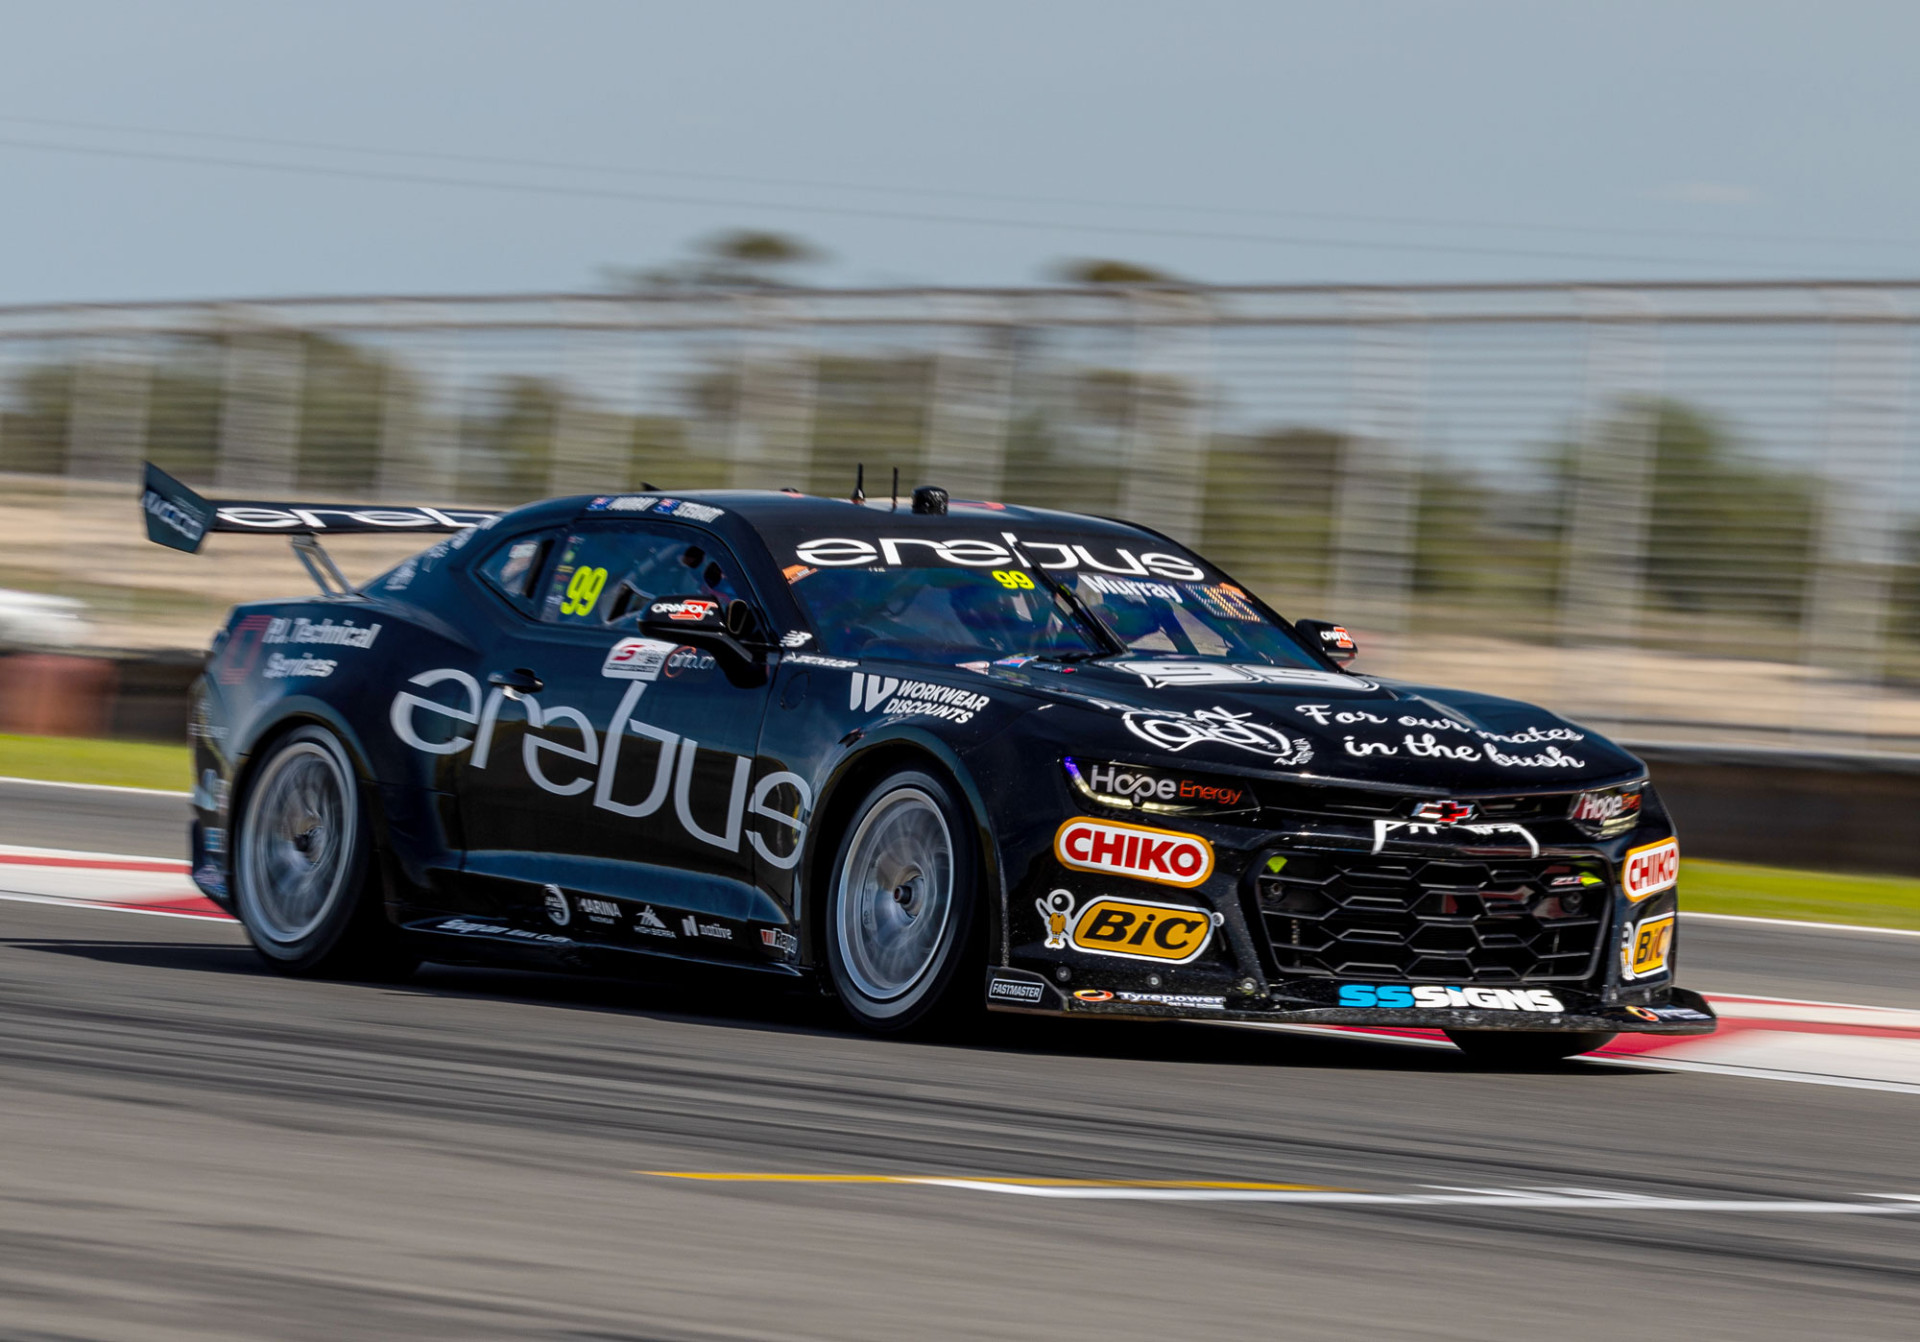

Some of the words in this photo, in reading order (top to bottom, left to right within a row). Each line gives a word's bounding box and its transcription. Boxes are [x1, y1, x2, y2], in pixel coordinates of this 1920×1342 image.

[215, 506, 500, 528] ereb
[796, 532, 1205, 580] erebus
[560, 565, 608, 616] 99
[992, 570, 1035, 590] 99
[1078, 573, 1183, 603] Murray
[883, 698, 974, 724] DISCOUNTS
[897, 680, 990, 712] WORKWEAR
[1295, 704, 1388, 725] For
[1398, 715, 1470, 732] our
[1476, 727, 1584, 743] mates
[1344, 735, 1398, 756] in
[1402, 733, 1481, 761] the
[1483, 746, 1585, 768] bush
[390, 668, 812, 869] erebus
[1090, 765, 1177, 803] Hope
[1179, 780, 1243, 806] Energy
[1581, 793, 1623, 825] Hope
[1065, 828, 1203, 877] CHIKO
[1629, 848, 1678, 892] CHIKO
[992, 983, 1041, 998] FASTMASTER
[1117, 991, 1226, 1004] Tyrepower
